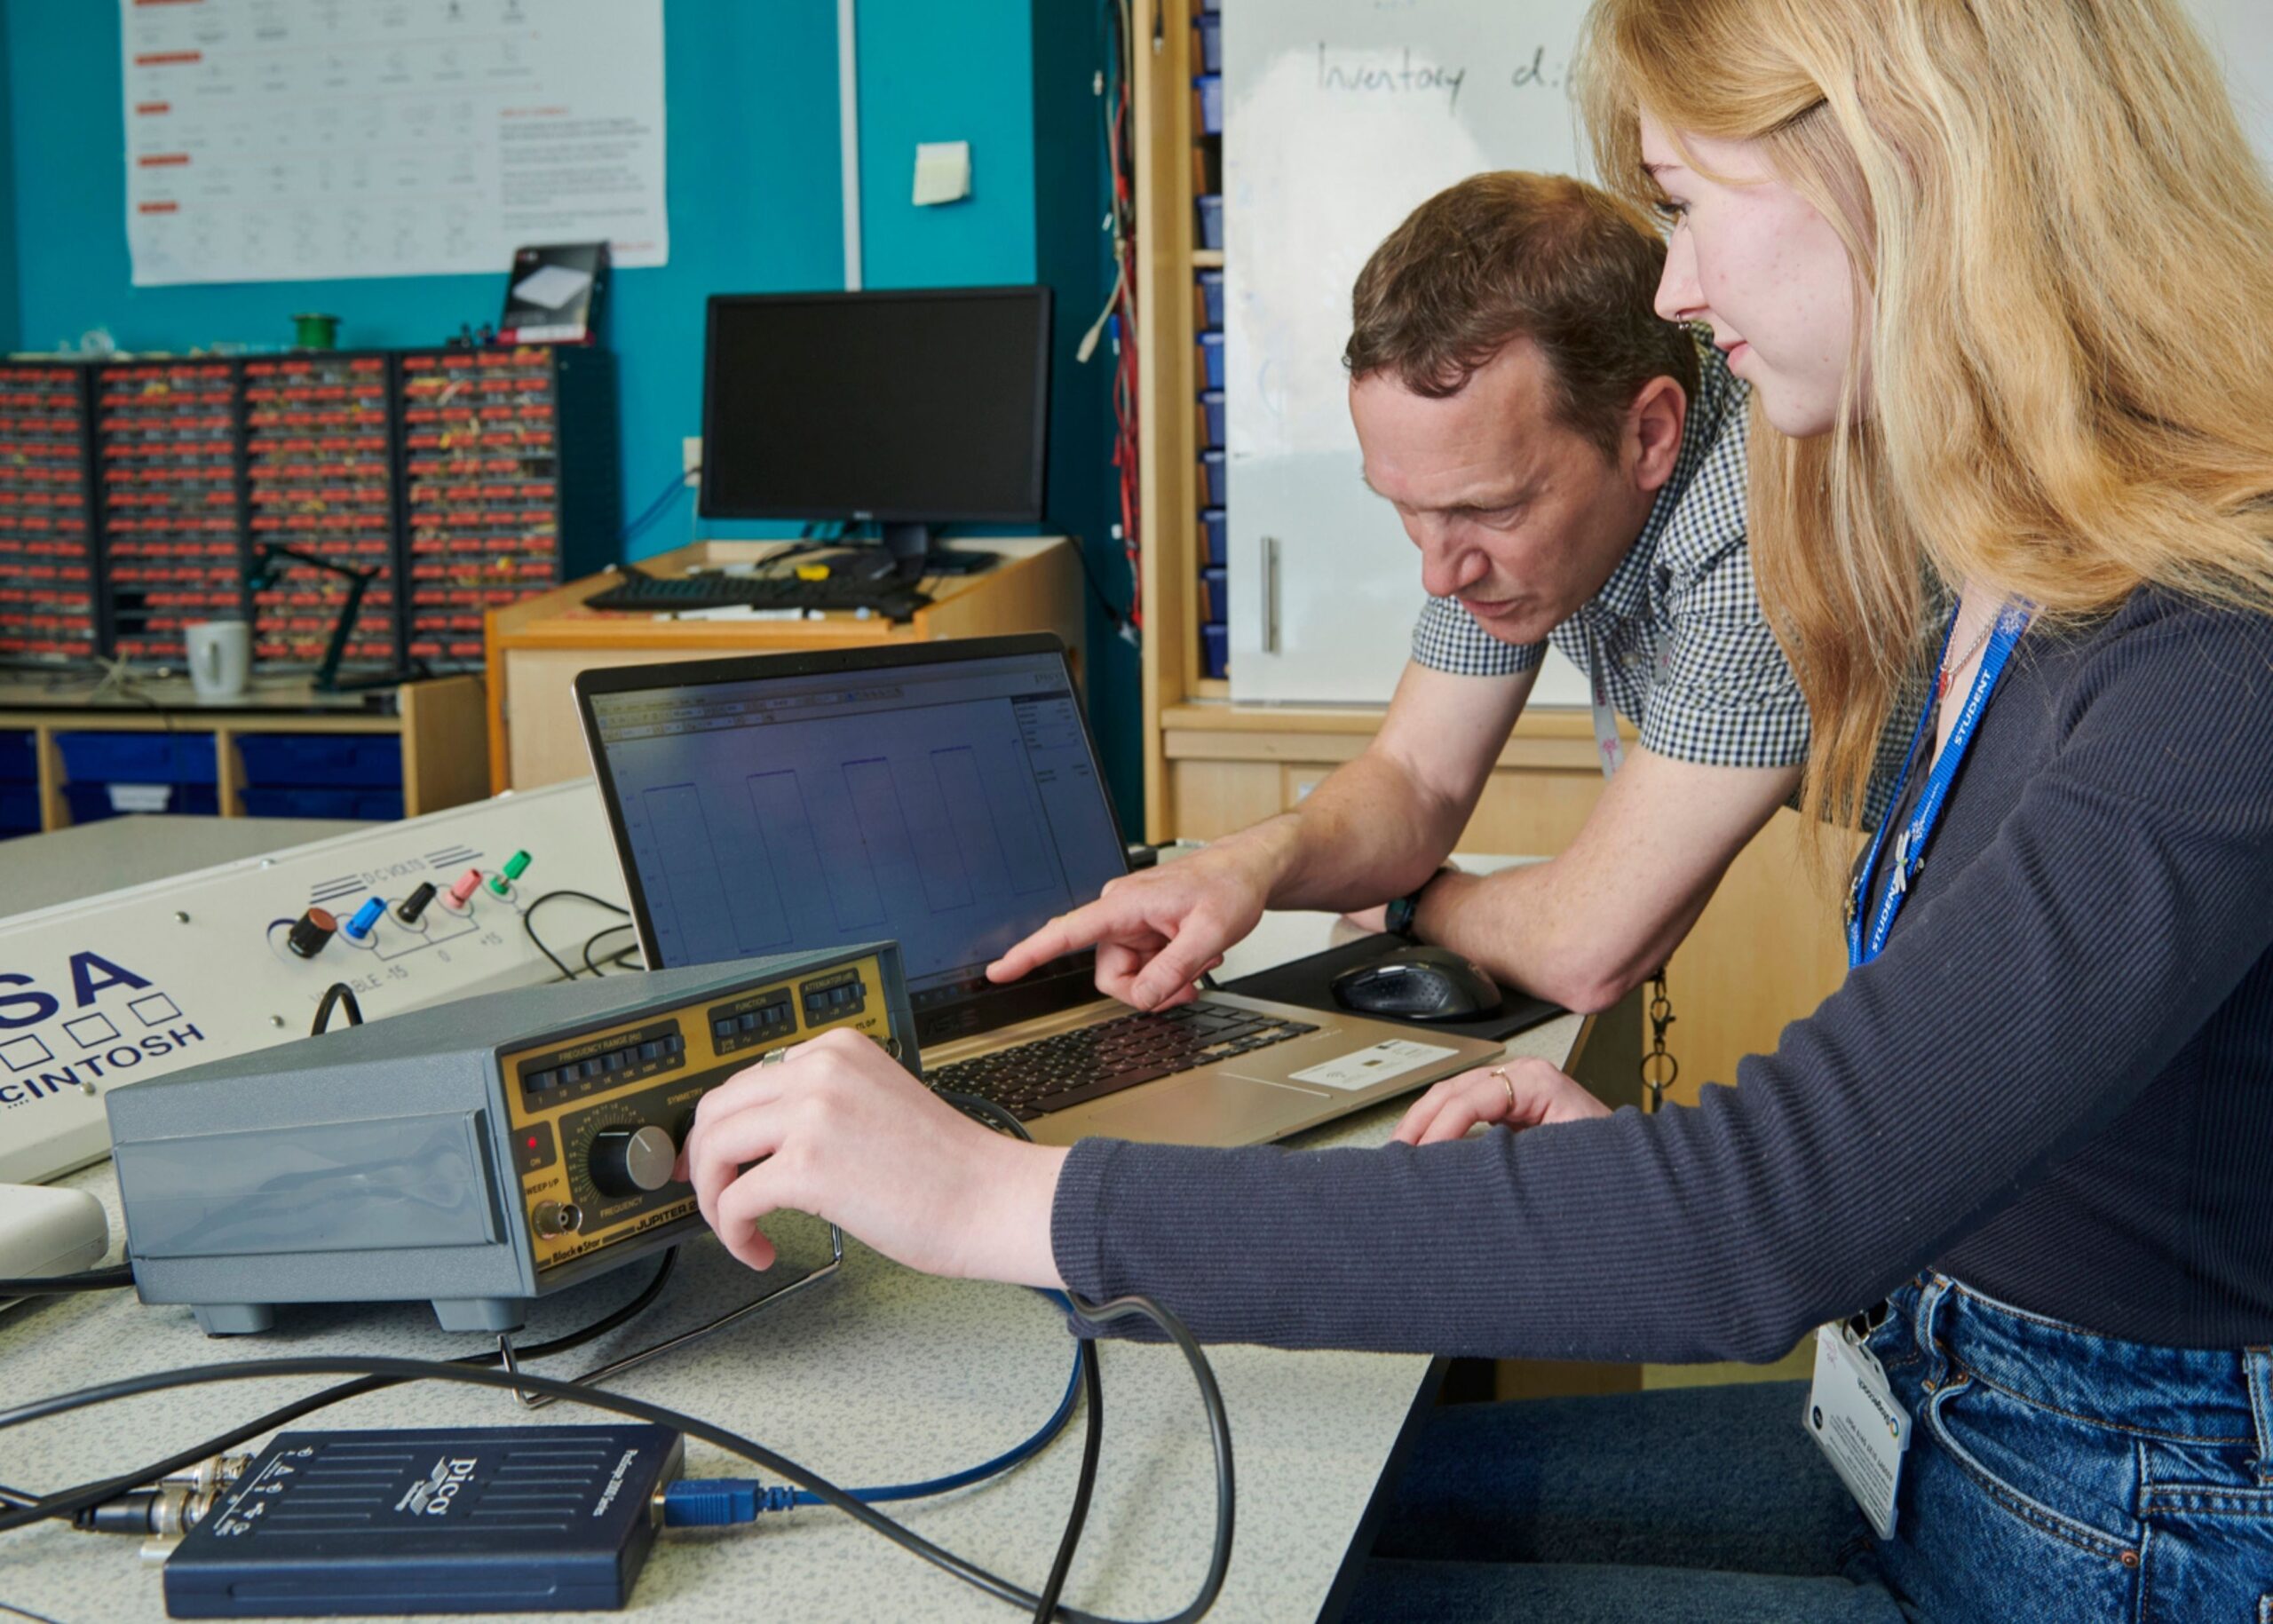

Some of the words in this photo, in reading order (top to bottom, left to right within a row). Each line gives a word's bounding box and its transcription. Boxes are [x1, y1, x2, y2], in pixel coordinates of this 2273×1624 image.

[1319, 41, 1465, 116] Inventory
[1953, 669, 1992, 746] STUDENT
[1873, 874, 1897, 952] STUDEN
[599, 1197, 644, 1219] FREQUENCY
[636, 1204, 688, 1232] JUPITER
[426, 1457, 479, 1515] pico
